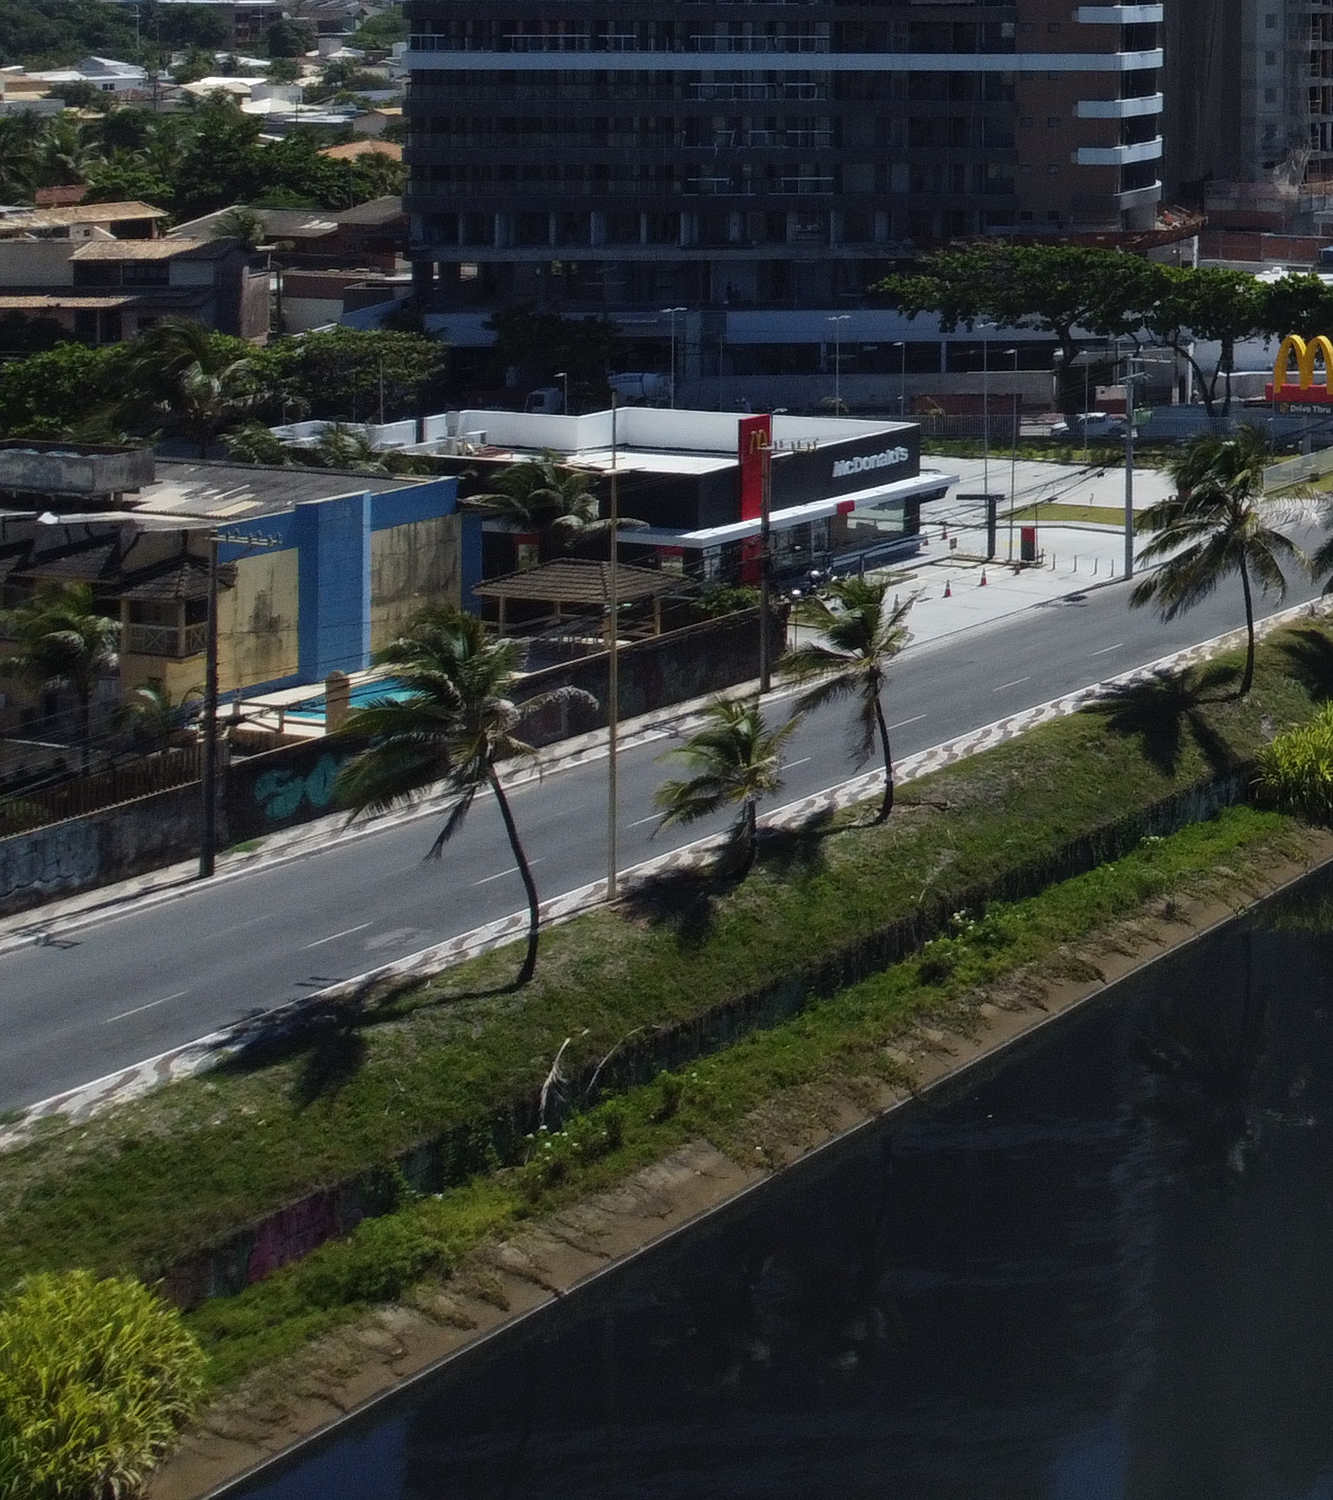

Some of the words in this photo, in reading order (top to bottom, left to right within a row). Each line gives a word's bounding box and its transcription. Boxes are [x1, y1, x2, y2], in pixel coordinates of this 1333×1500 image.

[1290, 404, 1311, 413] Drive
[1312, 405, 1331, 414] Thru
[832, 446, 909, 477] McDonald's
